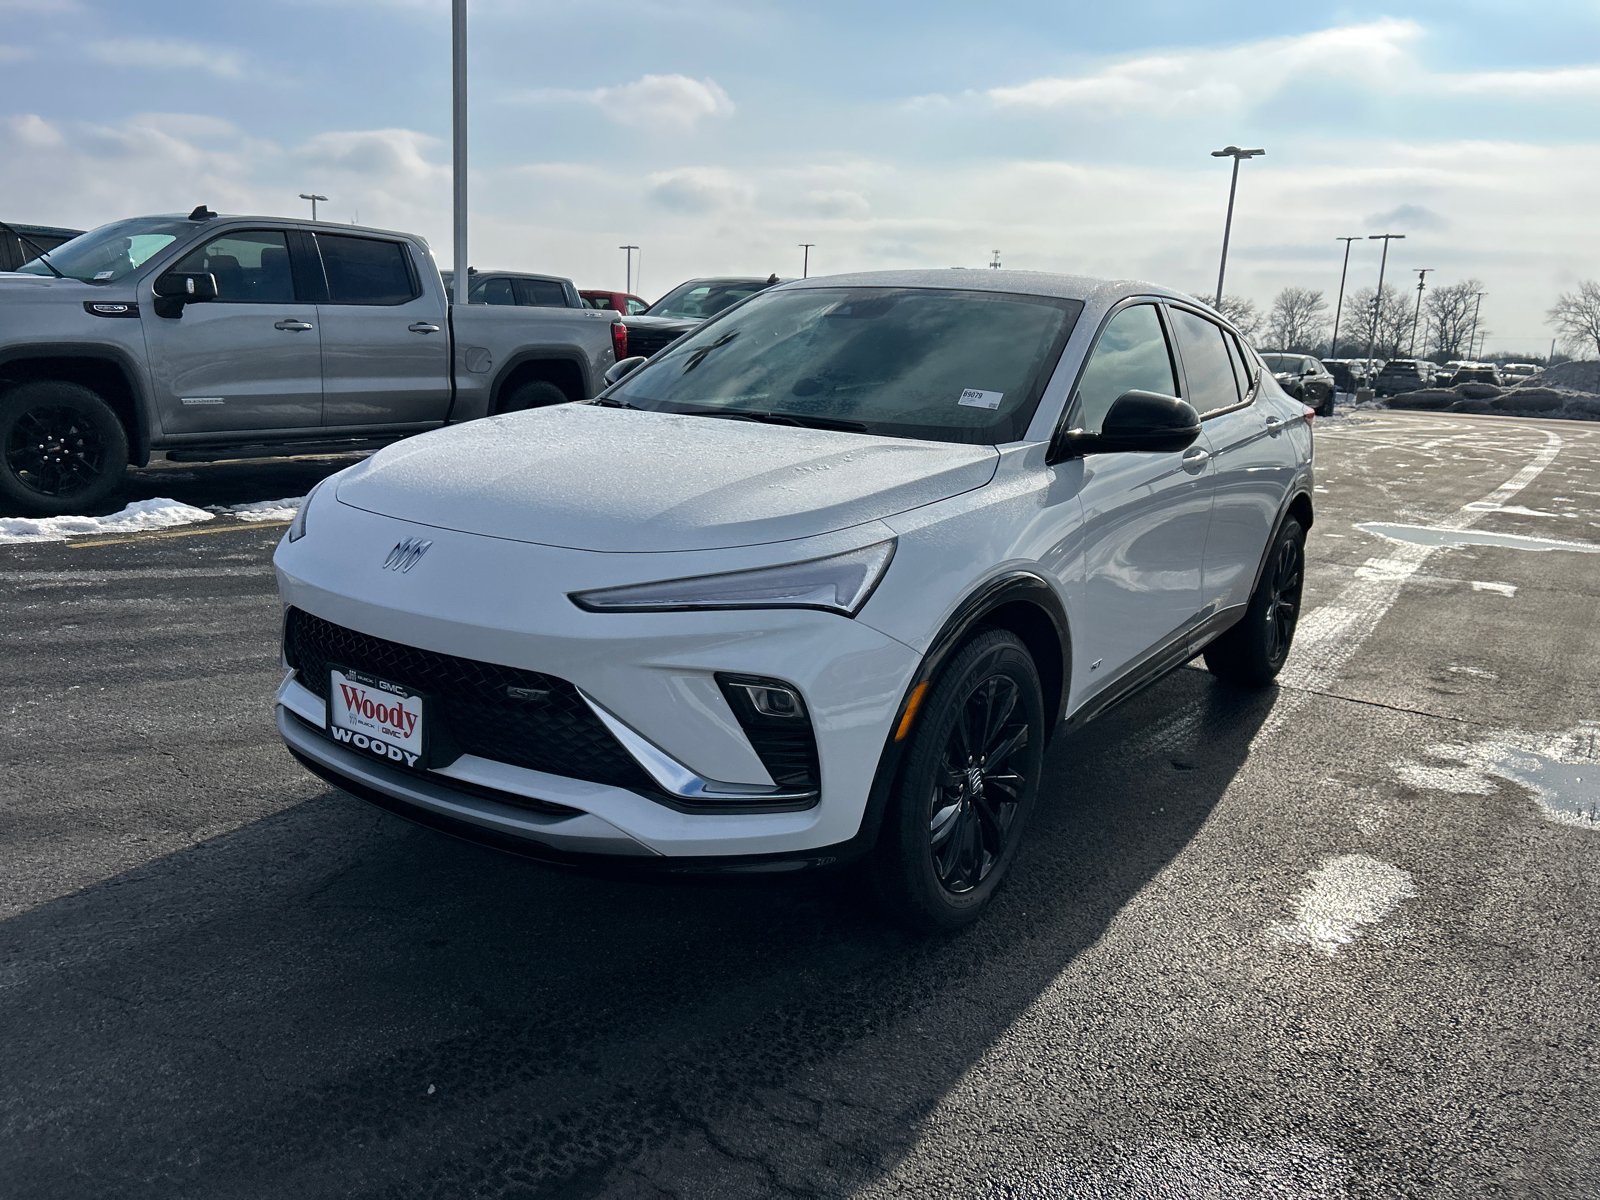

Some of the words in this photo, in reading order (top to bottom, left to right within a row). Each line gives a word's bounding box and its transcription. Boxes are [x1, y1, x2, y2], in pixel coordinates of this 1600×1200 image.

[357, 675, 374, 684] BUICK
[379, 680, 404, 695] GMC
[339, 683, 419, 739] Woody
[358, 719, 375, 729] BUICK
[381, 727, 401, 739] GMC
[331, 725, 419, 767] WOODY
